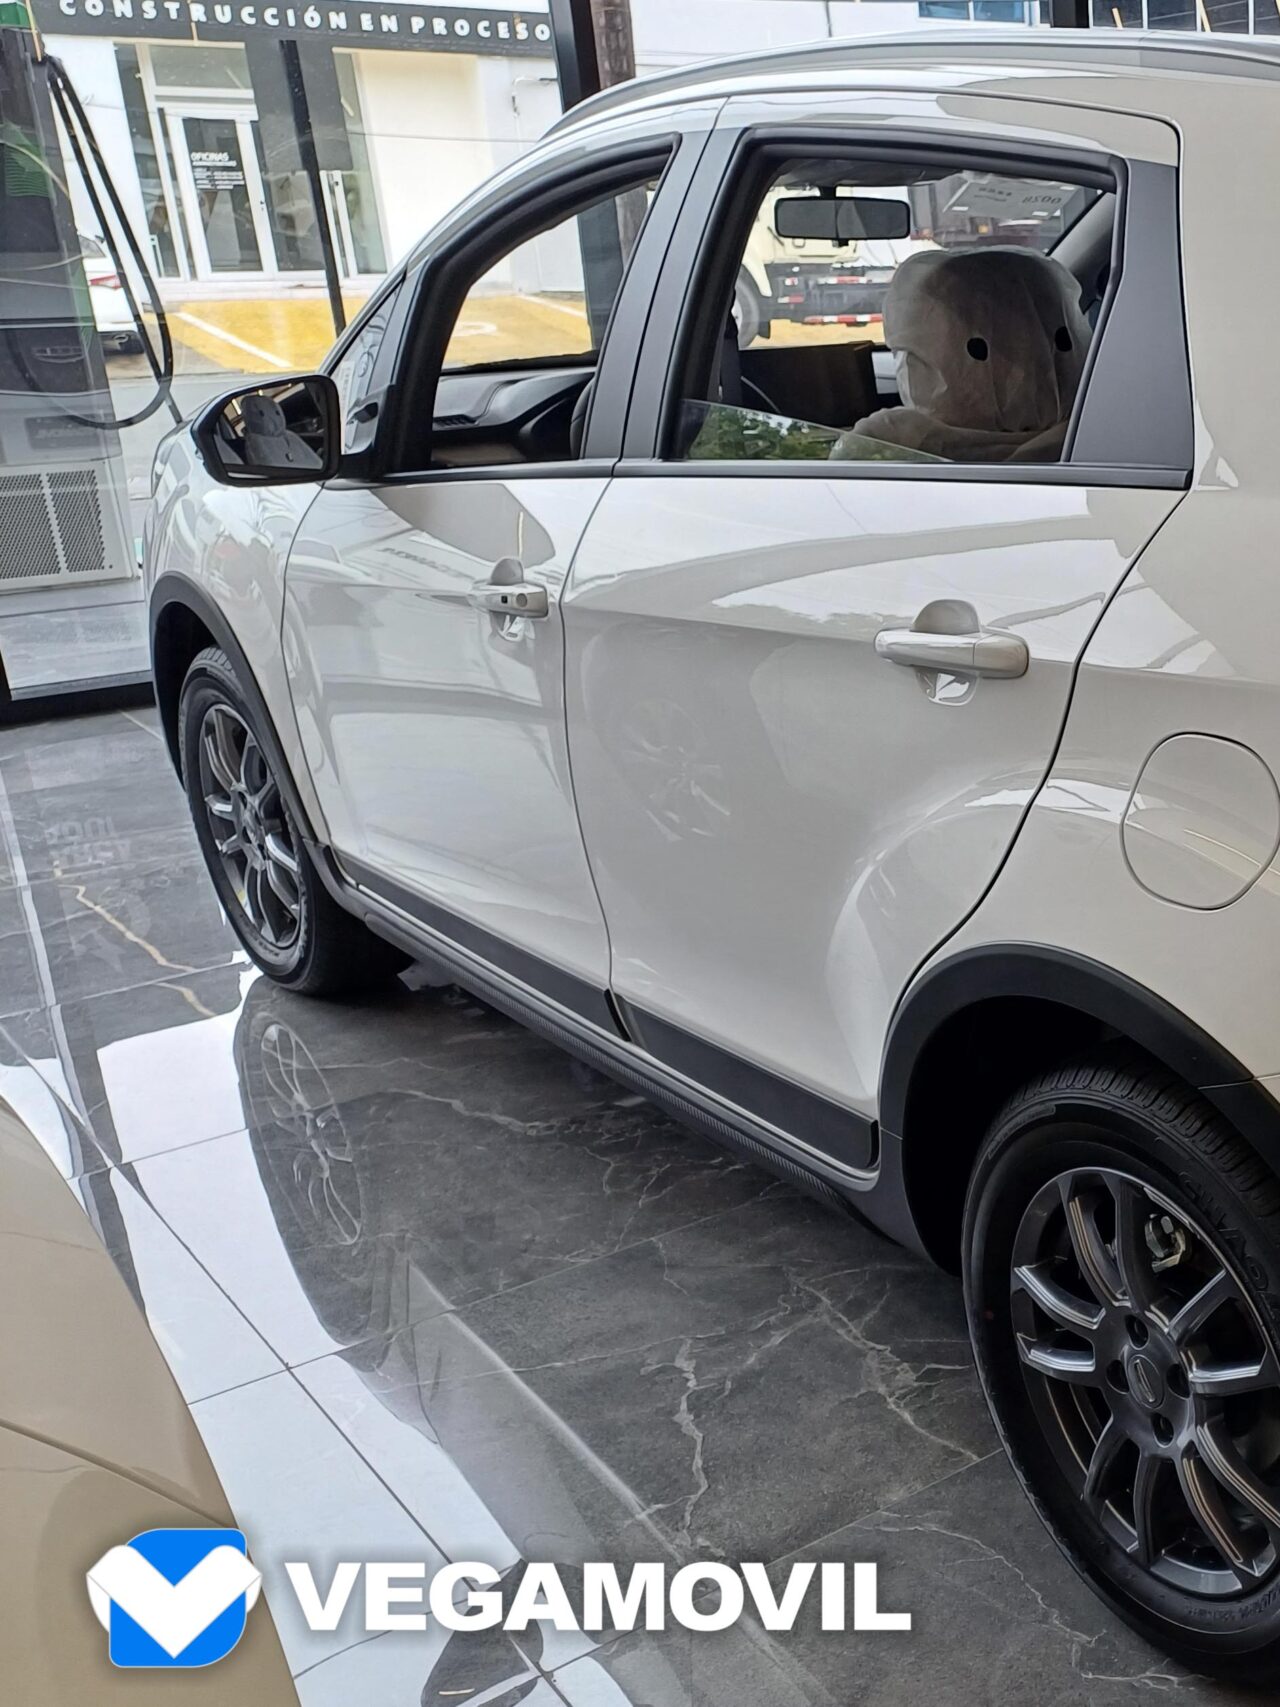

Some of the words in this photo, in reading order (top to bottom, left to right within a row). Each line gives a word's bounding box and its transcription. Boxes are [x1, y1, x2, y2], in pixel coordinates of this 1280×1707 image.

[59, 0, 348, 31] CONSTRUCCIÓN
[360, 13, 399, 33] EN
[410, 16, 550, 41] PROCESO
